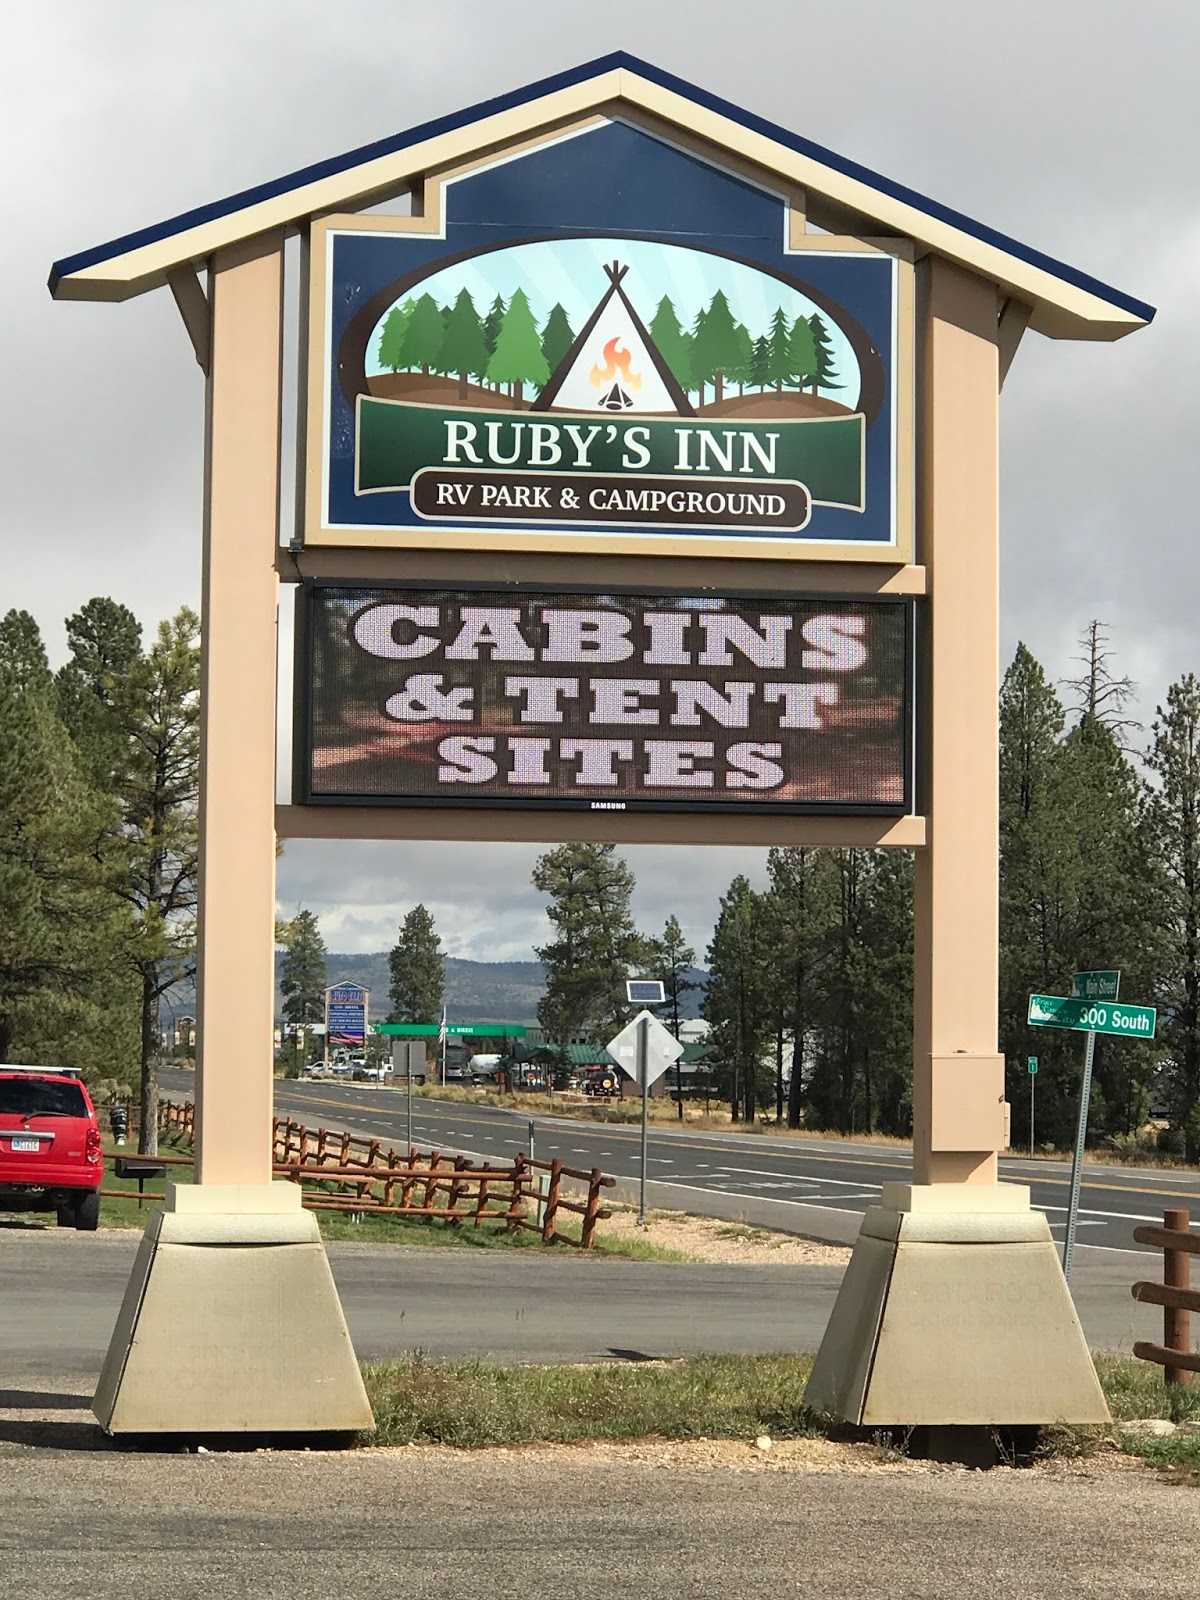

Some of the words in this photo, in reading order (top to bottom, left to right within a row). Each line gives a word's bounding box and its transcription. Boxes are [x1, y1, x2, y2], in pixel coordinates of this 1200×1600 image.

[443, 420, 651, 469] RUBY'S
[673, 428, 780, 474] INN
[436, 483, 474, 506] RV
[480, 484, 552, 509] PARK
[559, 487, 581, 509] &
[588, 488, 787, 516] CAMPGROUND
[354, 604, 868, 671] CABINS
[385, 673, 475, 722] &
[504, 675, 840, 729] TENT
[437, 736, 785, 790] SITES
[591, 802, 626, 810] SAMSUNG
[1099, 977, 1117, 995] Street
[1079, 1006, 1107, 1026] 300
[1111, 1010, 1150, 1031] South
